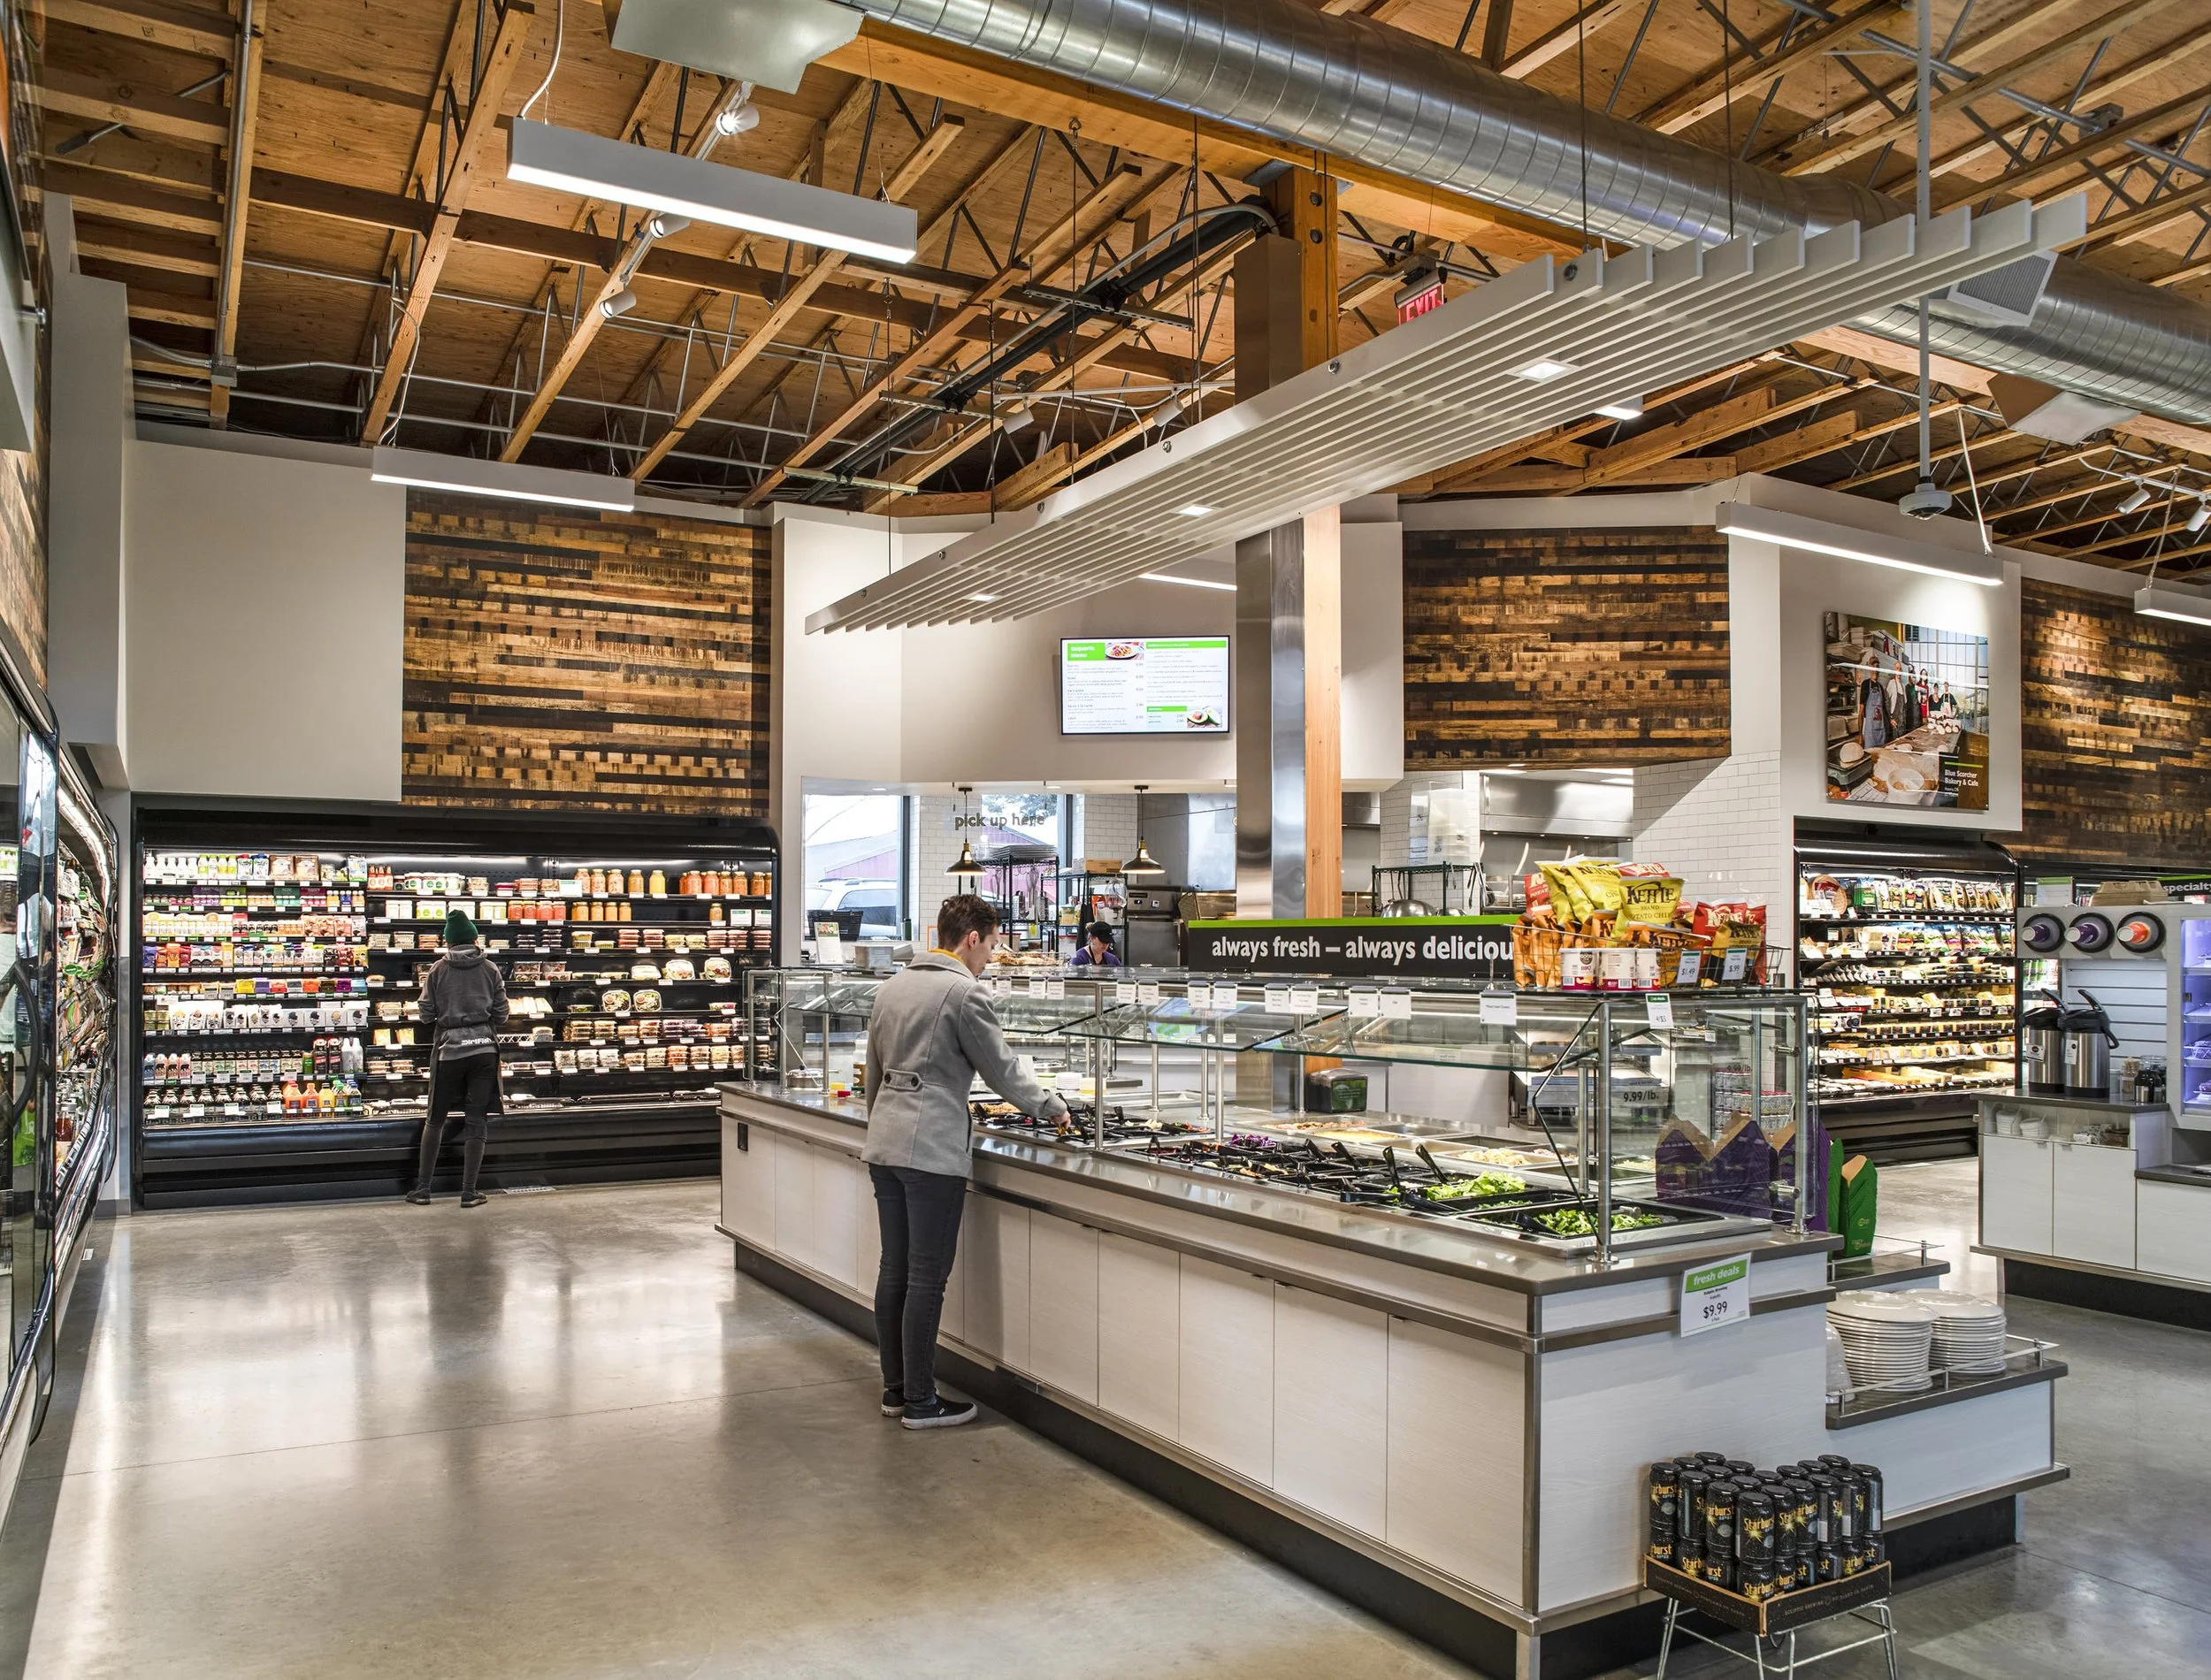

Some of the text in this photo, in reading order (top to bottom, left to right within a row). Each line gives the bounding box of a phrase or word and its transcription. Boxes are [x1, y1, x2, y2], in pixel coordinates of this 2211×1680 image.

[1405, 288, 1438, 322] EXIT
[1944, 777, 1962, 787] Bakery
[954, 813, 1045, 830] pick up here
[1529, 887, 1549, 898] POTAT
[1626, 881, 1677, 905] KETTLE
[1212, 935, 1268, 963] always
[1273, 935, 1320, 958] fresh
[1345, 935, 1416, 966] always
[1422, 935, 1514, 960] deliciou
[1681, 967, 1695, 976] $1.49
[1728, 964, 1740, 973] $.99
[1623, 1089, 1659, 1103] 9.99/lb.
[1693, 1265, 1740, 1287] fresh deals
[1703, 1301, 1728, 1319] $9.99
[1744, 1516, 1775, 1531] Starburs
[1744, 1579, 1775, 1595] Starburs
